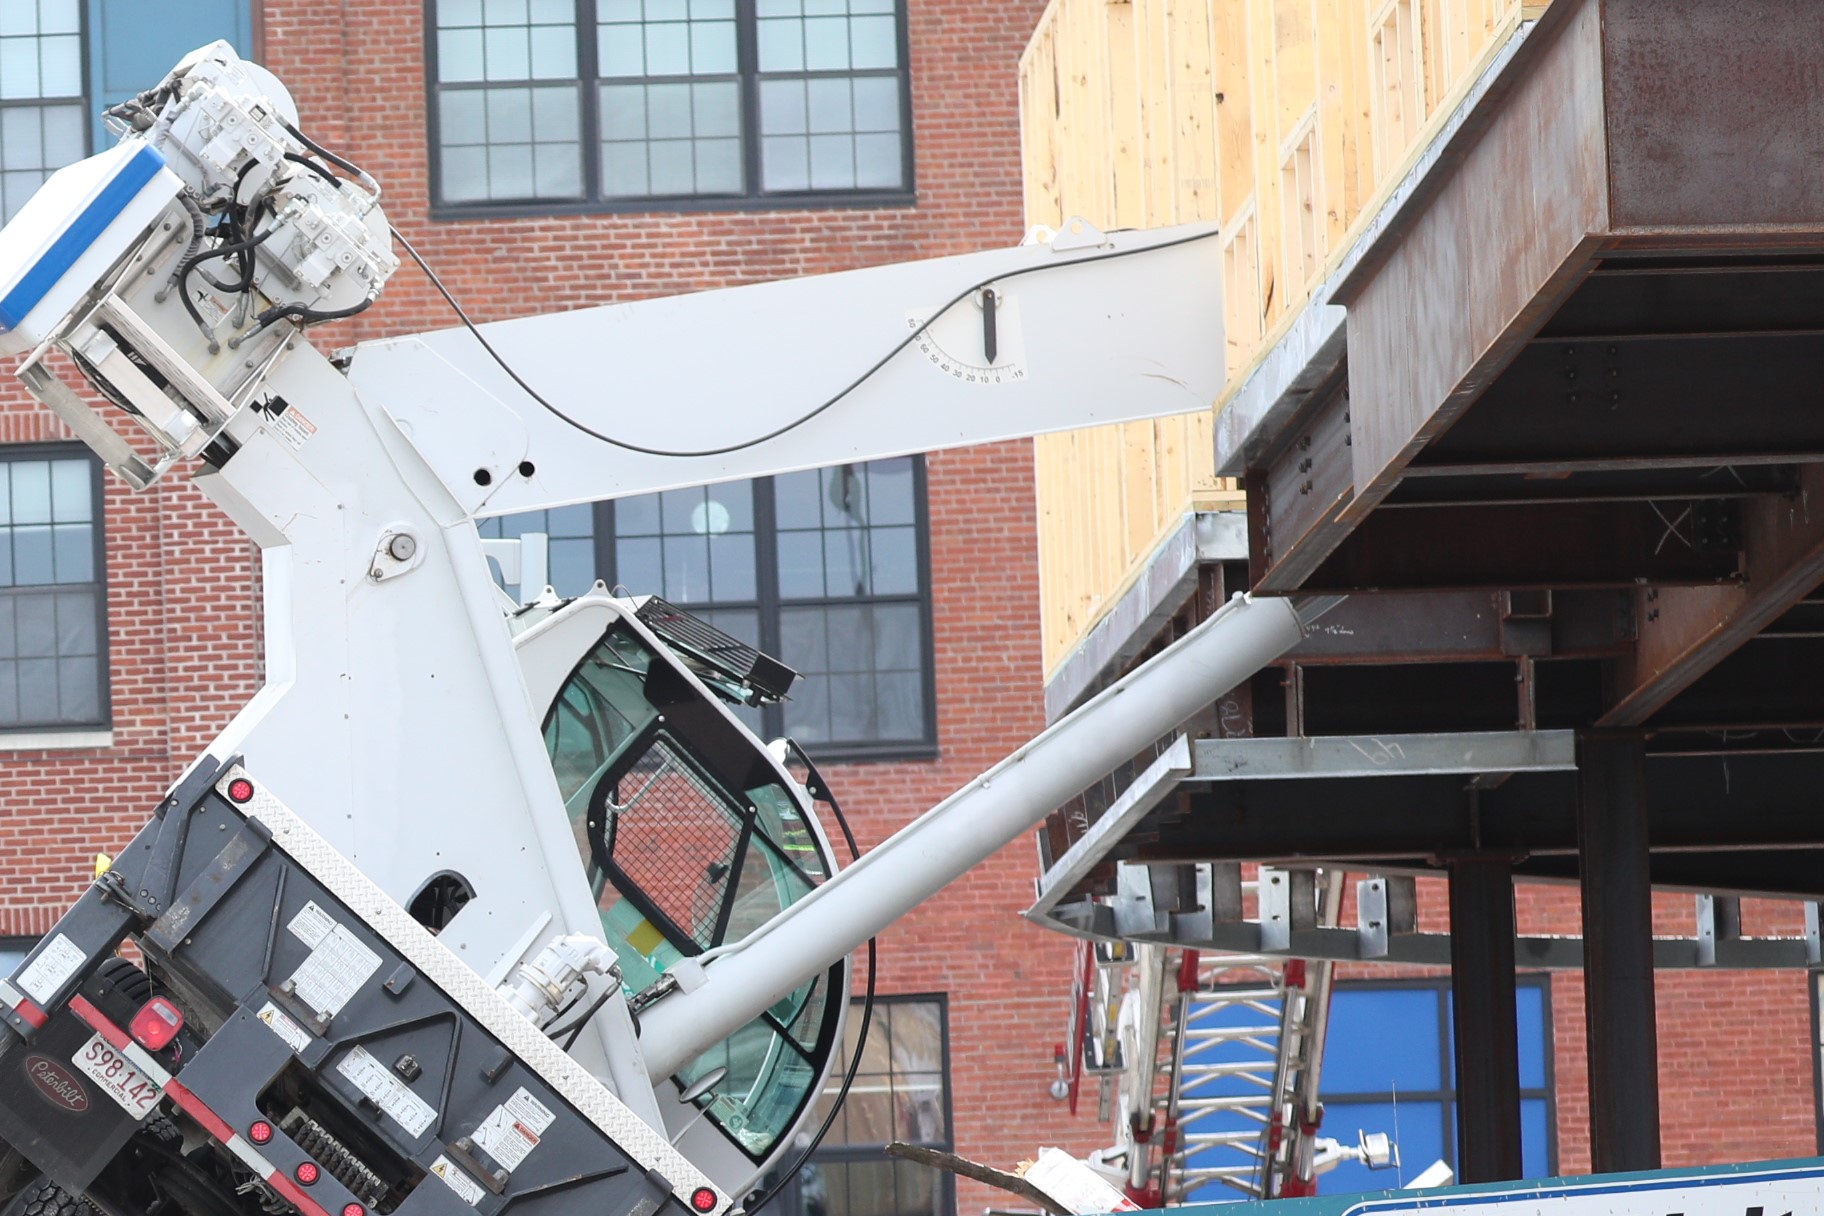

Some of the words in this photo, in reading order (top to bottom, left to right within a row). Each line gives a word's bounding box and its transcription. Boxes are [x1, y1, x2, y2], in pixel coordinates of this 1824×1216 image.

[920, 343, 930, 354] 60
[929, 354, 939, 364] 50
[940, 363, 950, 372] 40
[952, 370, 963, 378] 30
[965, 374, 976, 383] 20
[995, 375, 1001, 383] 0
[30, 1061, 85, 1107] Peterbilt
[91, 1069, 127, 1103] COMMERCIAL
